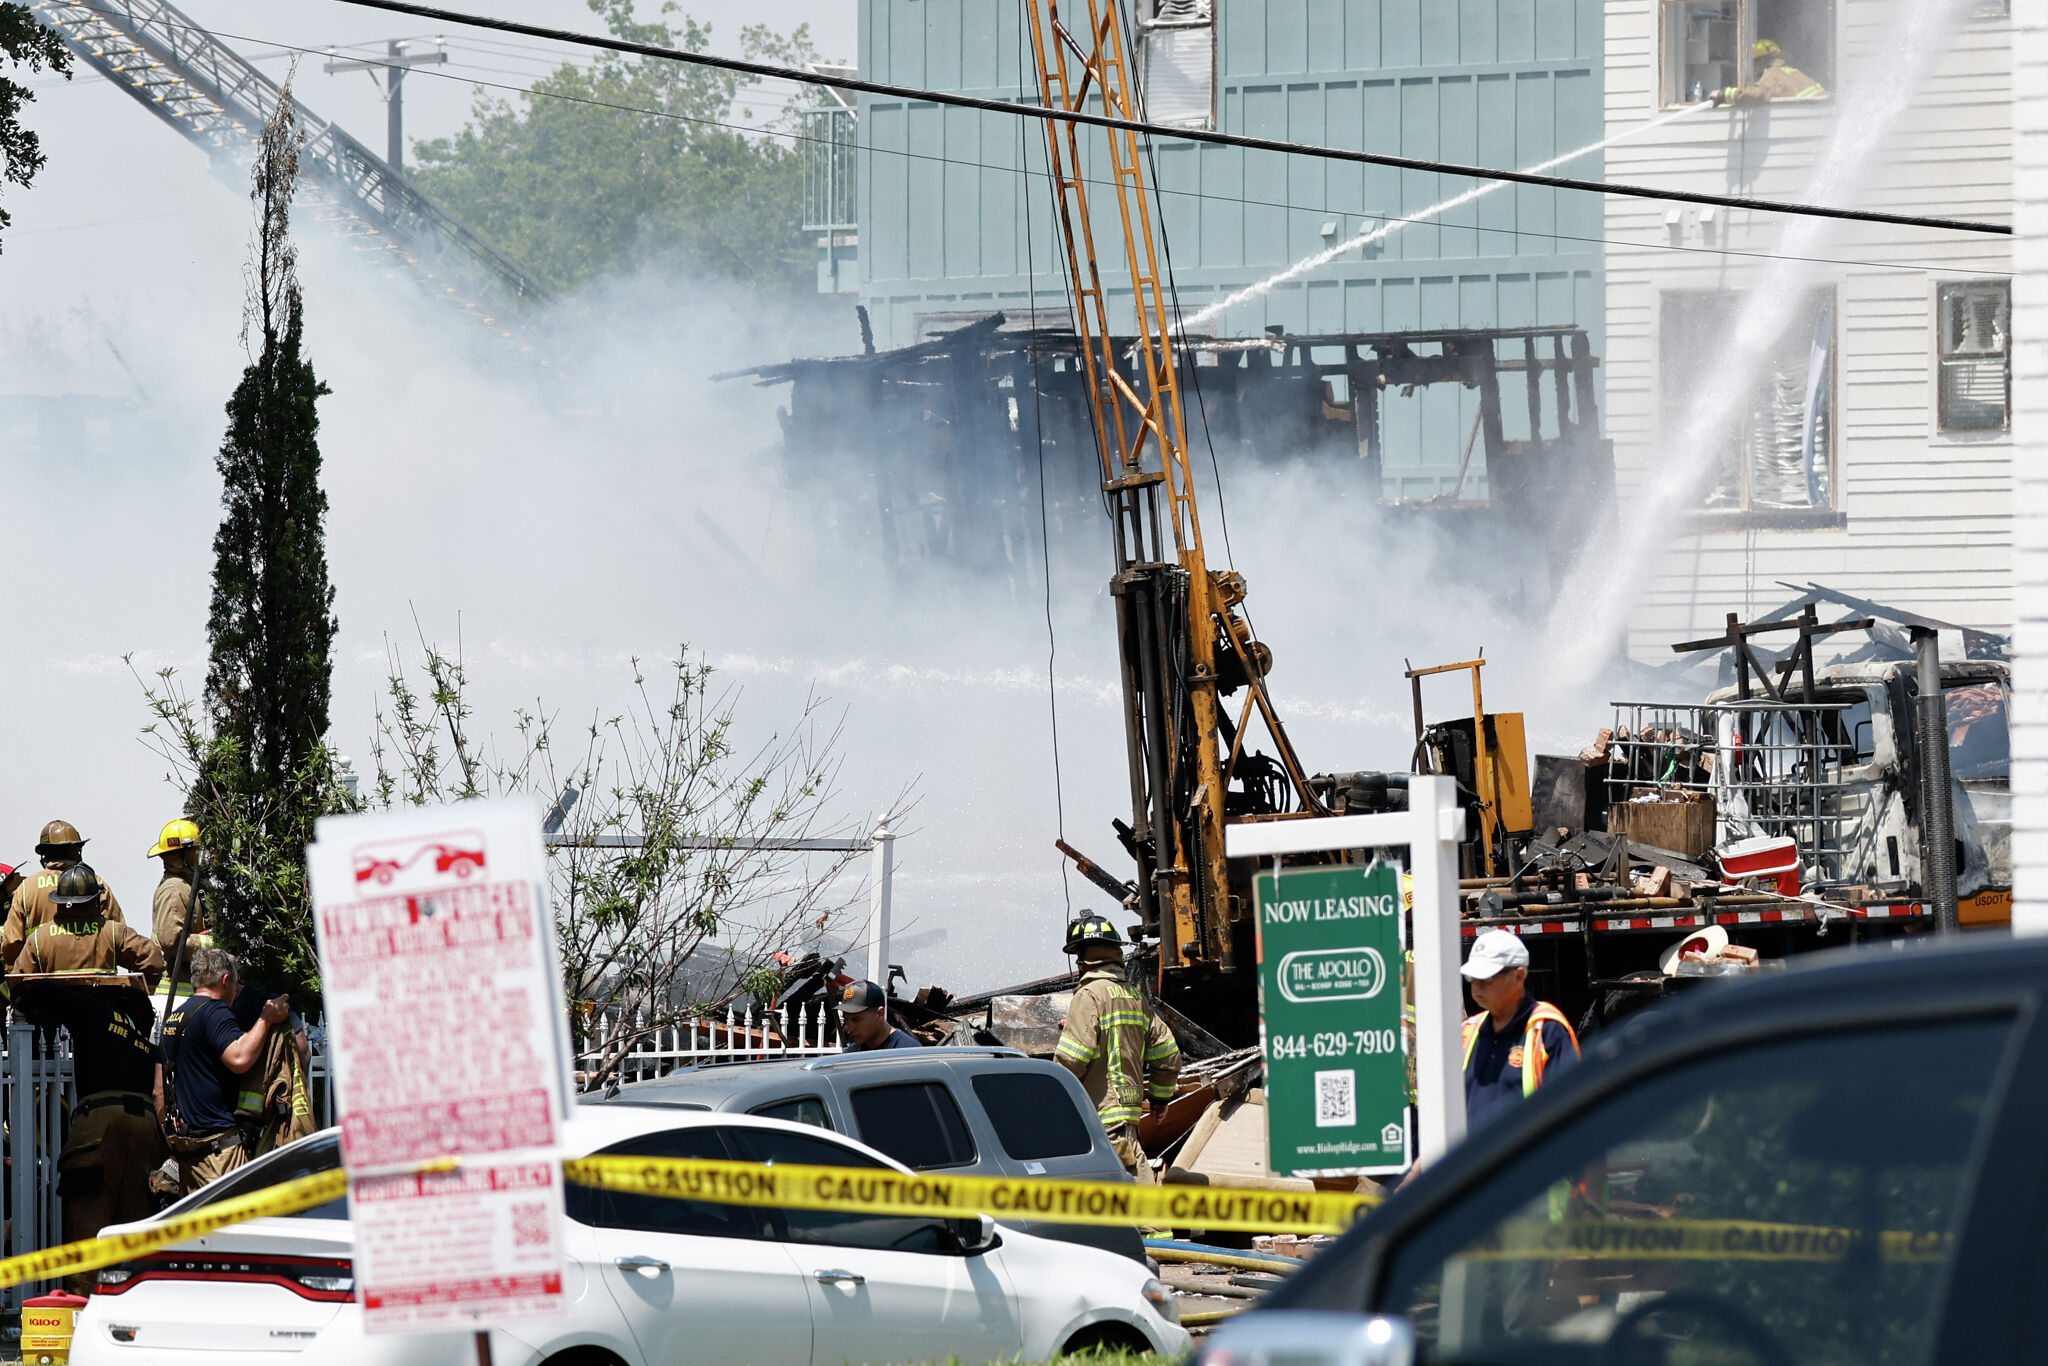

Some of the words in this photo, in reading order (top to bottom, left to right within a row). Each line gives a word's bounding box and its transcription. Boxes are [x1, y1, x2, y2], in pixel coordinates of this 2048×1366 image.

[1264, 899, 1311, 923] NOW
[1314, 894, 1394, 920] LEASING
[1975, 894, 2004, 906] USDOT
[50, 922, 98, 936] DALLAS
[1291, 962, 1315, 980] THE
[1317, 958, 1372, 979] APOLLO
[108, 1023, 129, 1038] FIRE
[1272, 1029, 1396, 1060] 844-629-7910
[641, 1165, 776, 1197] CAUTION
[815, 1172, 951, 1208] CAUTION
[990, 1183, 1130, 1216] CAUTION
[1170, 1192, 1312, 1224] CAUTION
[1543, 1223, 1684, 1250] CAUTION
[1722, 1225, 1850, 1254] CAUTIO
[169, 1262, 250, 1271] DODGE
[29, 1318, 61, 1327] IGLOO
